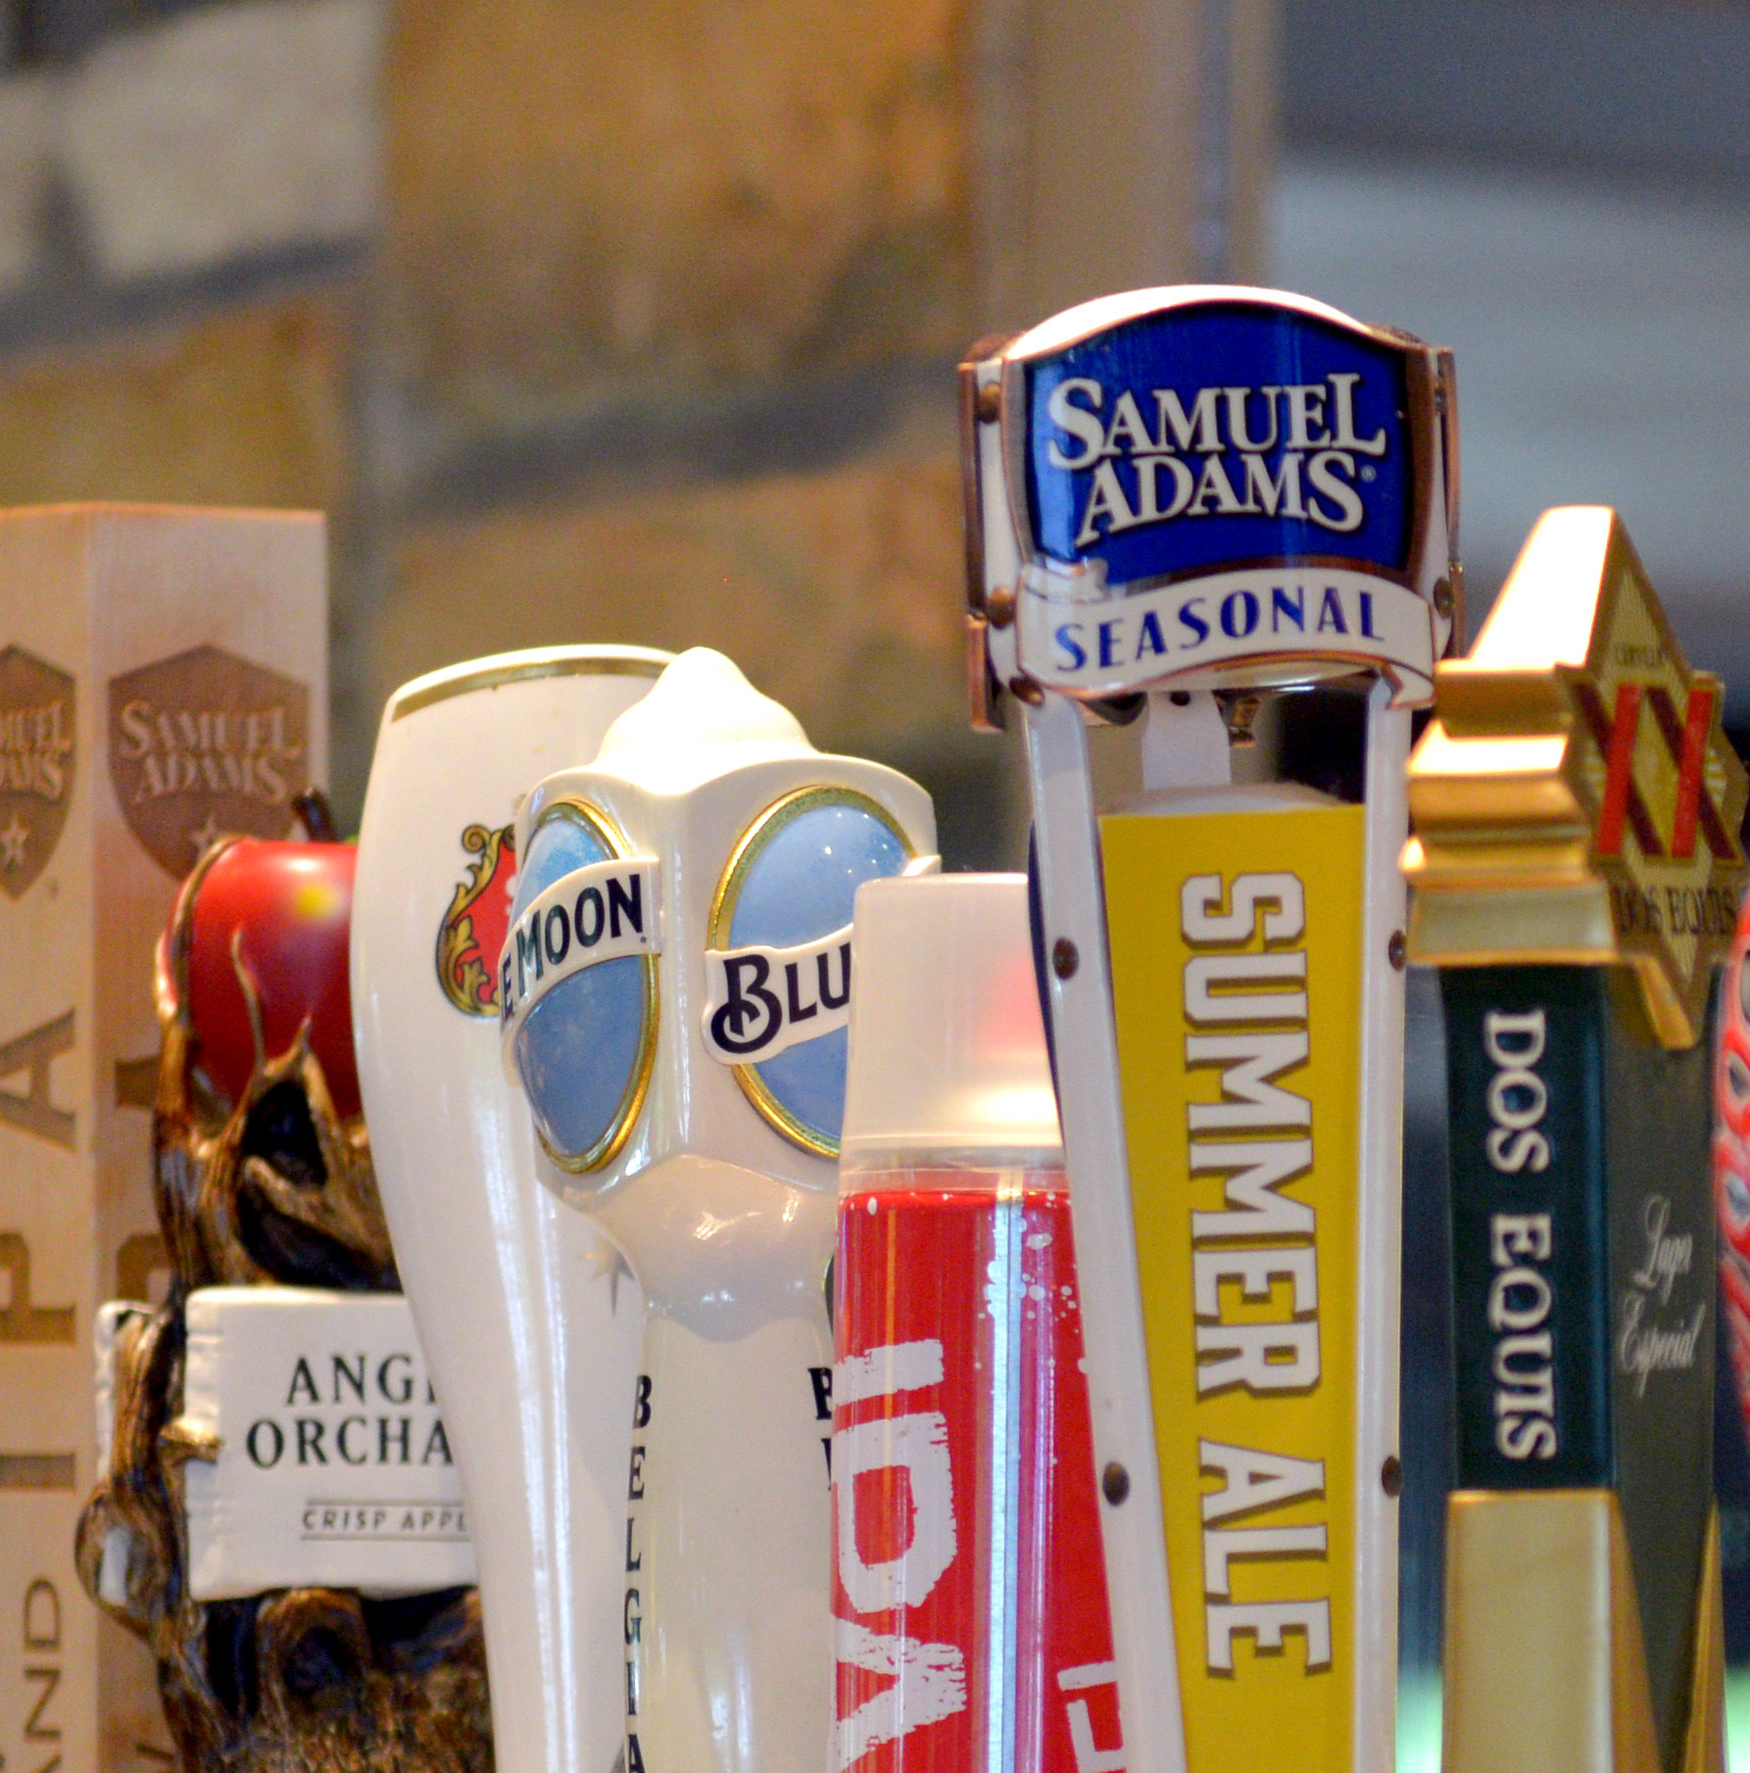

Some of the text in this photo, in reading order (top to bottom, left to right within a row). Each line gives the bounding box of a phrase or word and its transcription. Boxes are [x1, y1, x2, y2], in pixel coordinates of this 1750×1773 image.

[1048, 372, 1387, 471] SAMUEL
[1075, 449, 1363, 549] ADAMS
[1055, 586, 1385, 674] SEASONAL
[119, 700, 303, 760] SAMUEL
[134, 751, 288, 804] ADAMS
[515, 873, 644, 1000] MOON
[711, 942, 852, 1056] BLU
[1181, 871, 1333, 1680] SUMMER ALE
[1482, 1008, 1558, 1462] DOS EQUIS
[285, 1353, 437, 1407] ANG
[246, 1415, 455, 1469] ORCHA
[303, 1510, 467, 1532] CRISP APPL
